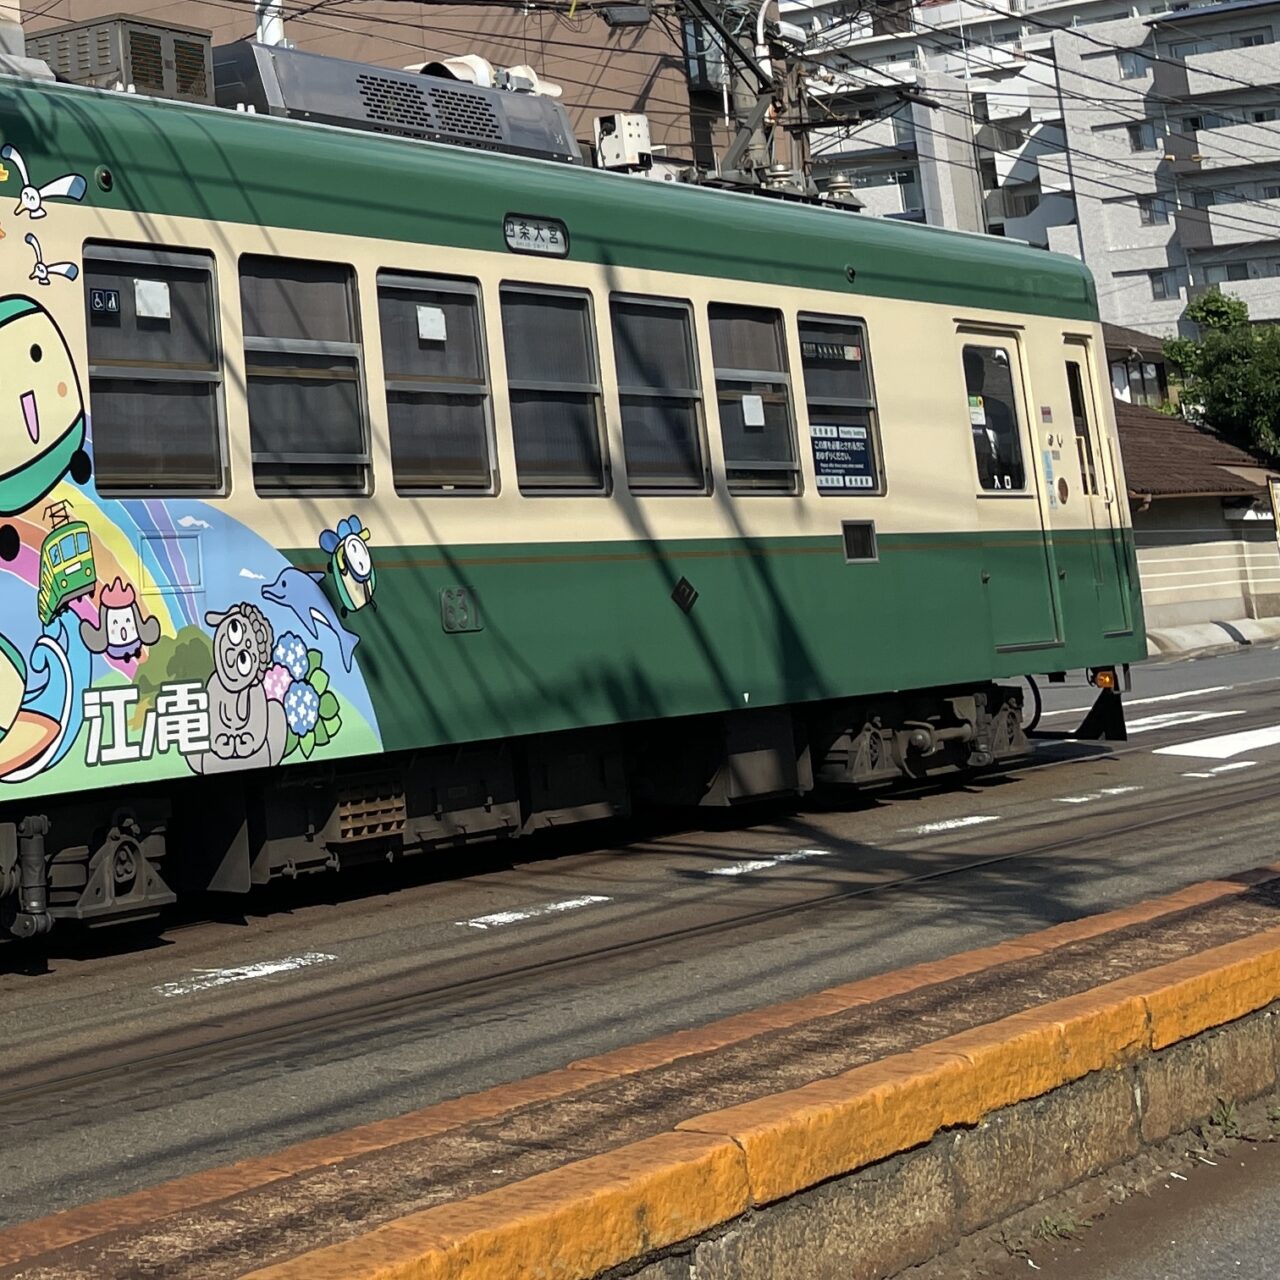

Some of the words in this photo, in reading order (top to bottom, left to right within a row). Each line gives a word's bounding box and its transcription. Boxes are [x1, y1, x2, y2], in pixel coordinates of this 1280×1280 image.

[506, 220, 559, 245] 四条大宮
[994, 475, 1012, 489] 入口
[82, 680, 211, 766] 江ノ電
